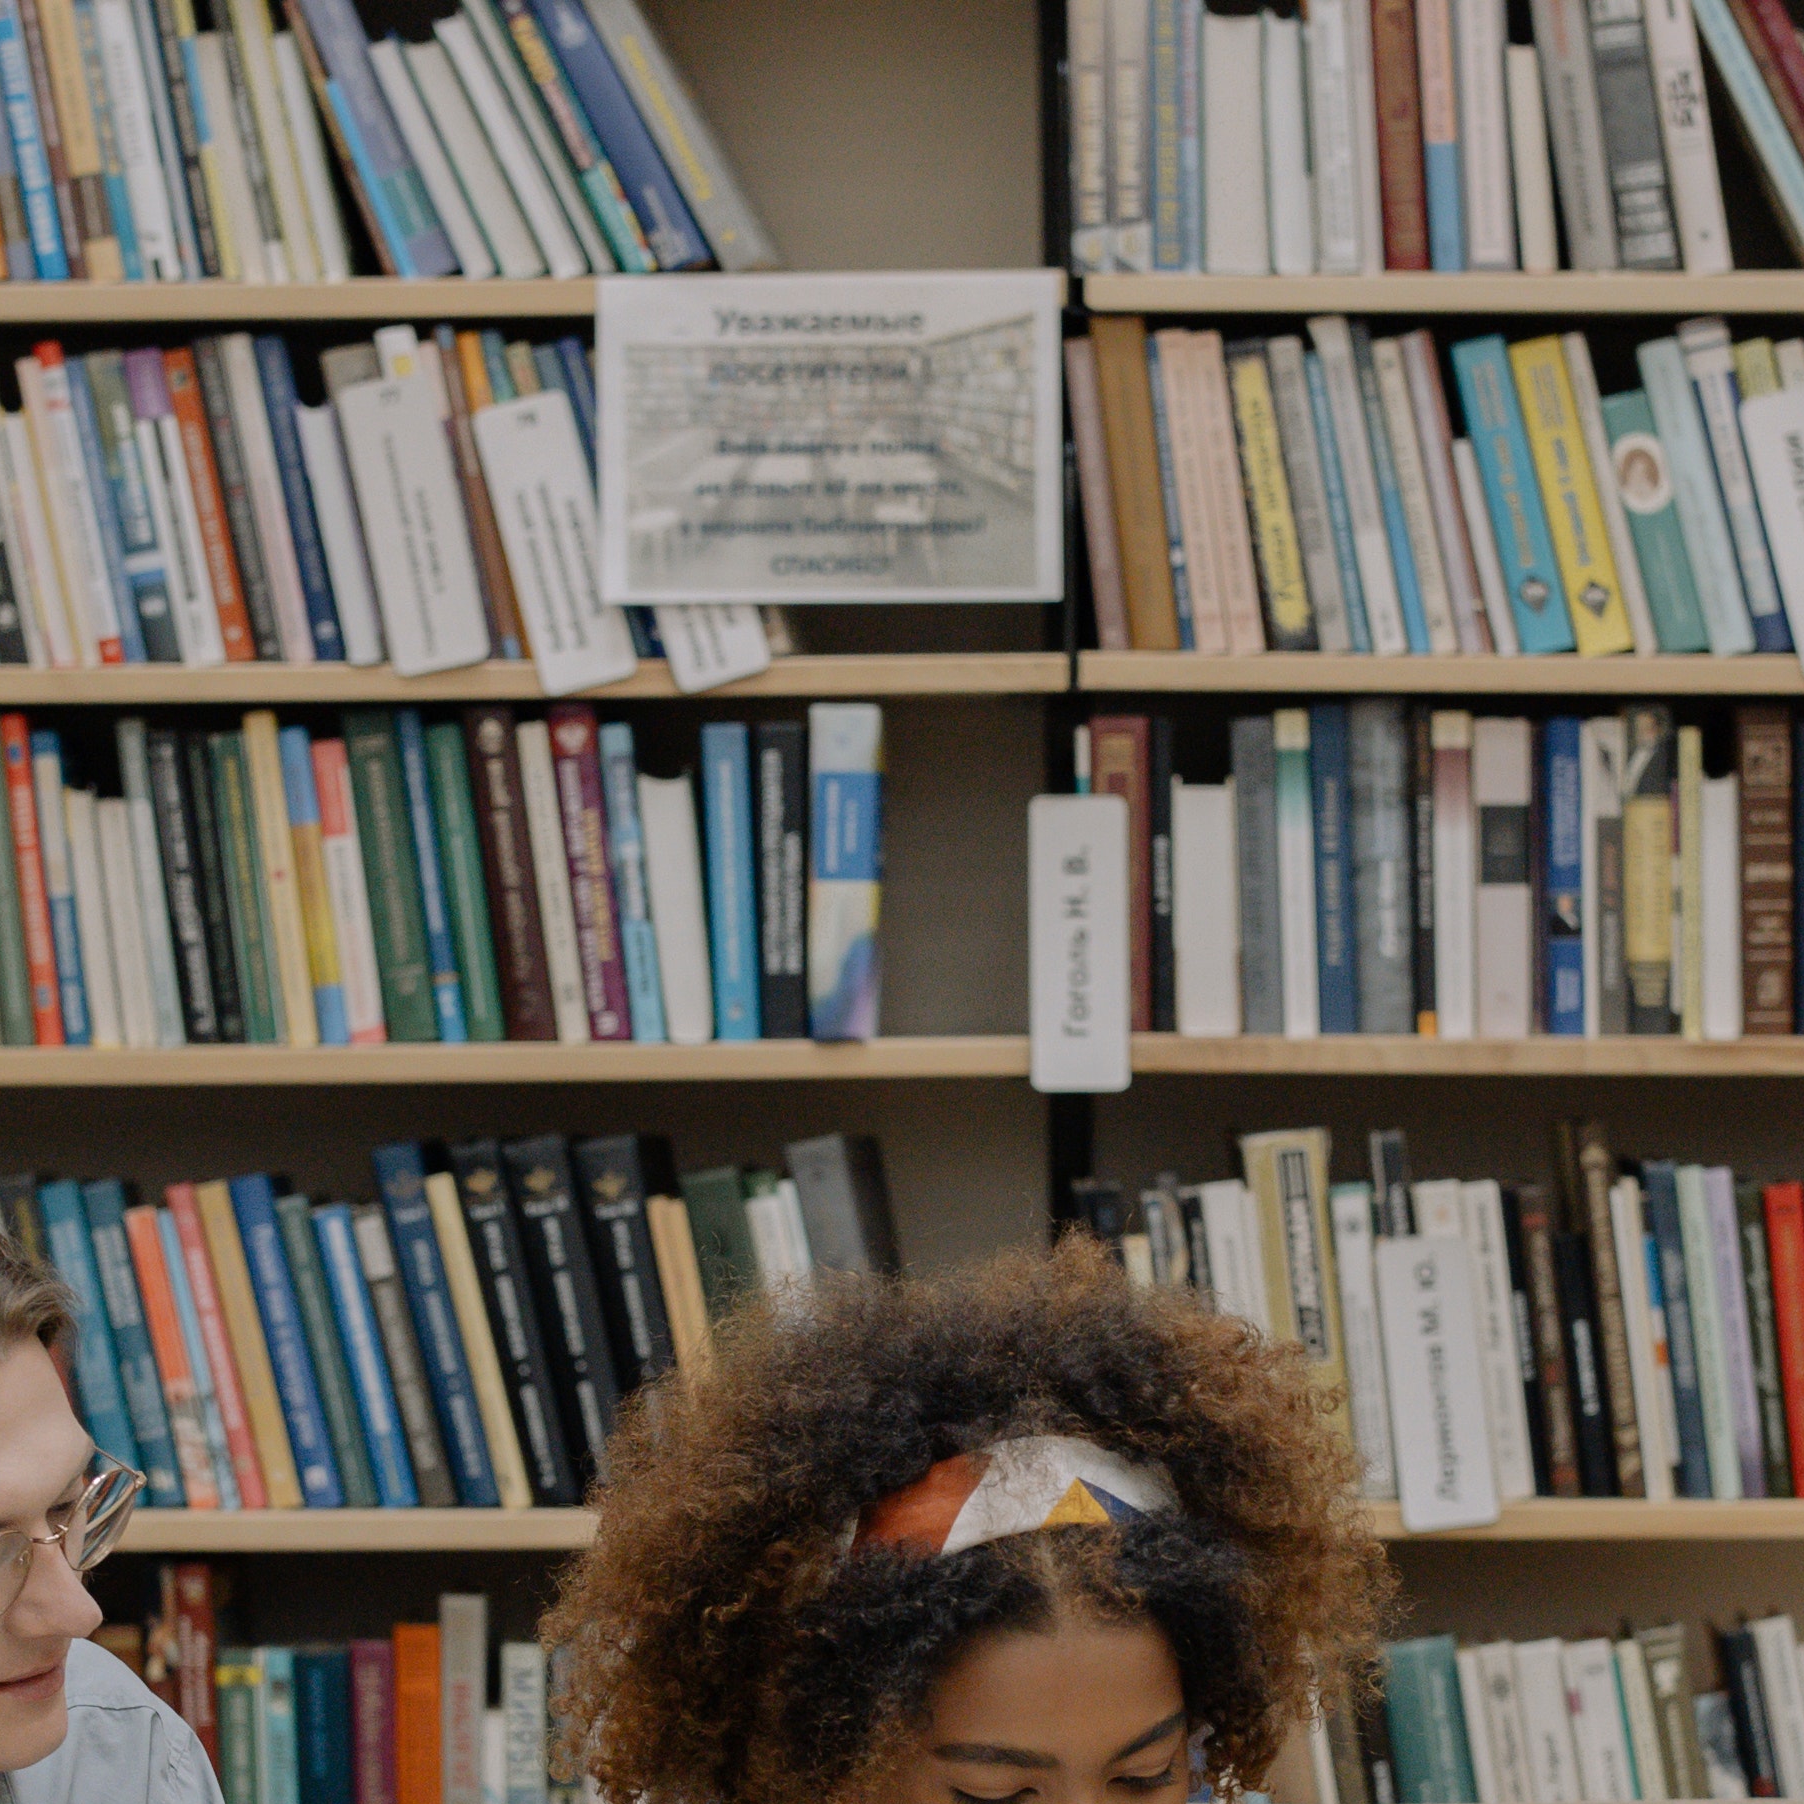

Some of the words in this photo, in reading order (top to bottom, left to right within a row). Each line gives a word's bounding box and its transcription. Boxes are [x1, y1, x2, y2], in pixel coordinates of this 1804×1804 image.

[713, 307, 926, 339] Уважаемые
[1061, 845, 1084, 876] В.
[1061, 886, 1085, 920] Н.
[1062, 930, 1091, 1039] Гоголь
[1412, 1251, 1437, 1293] Ю.
[1417, 1301, 1442, 1336] М.
[1425, 1344, 1461, 1502] Лермонтов
